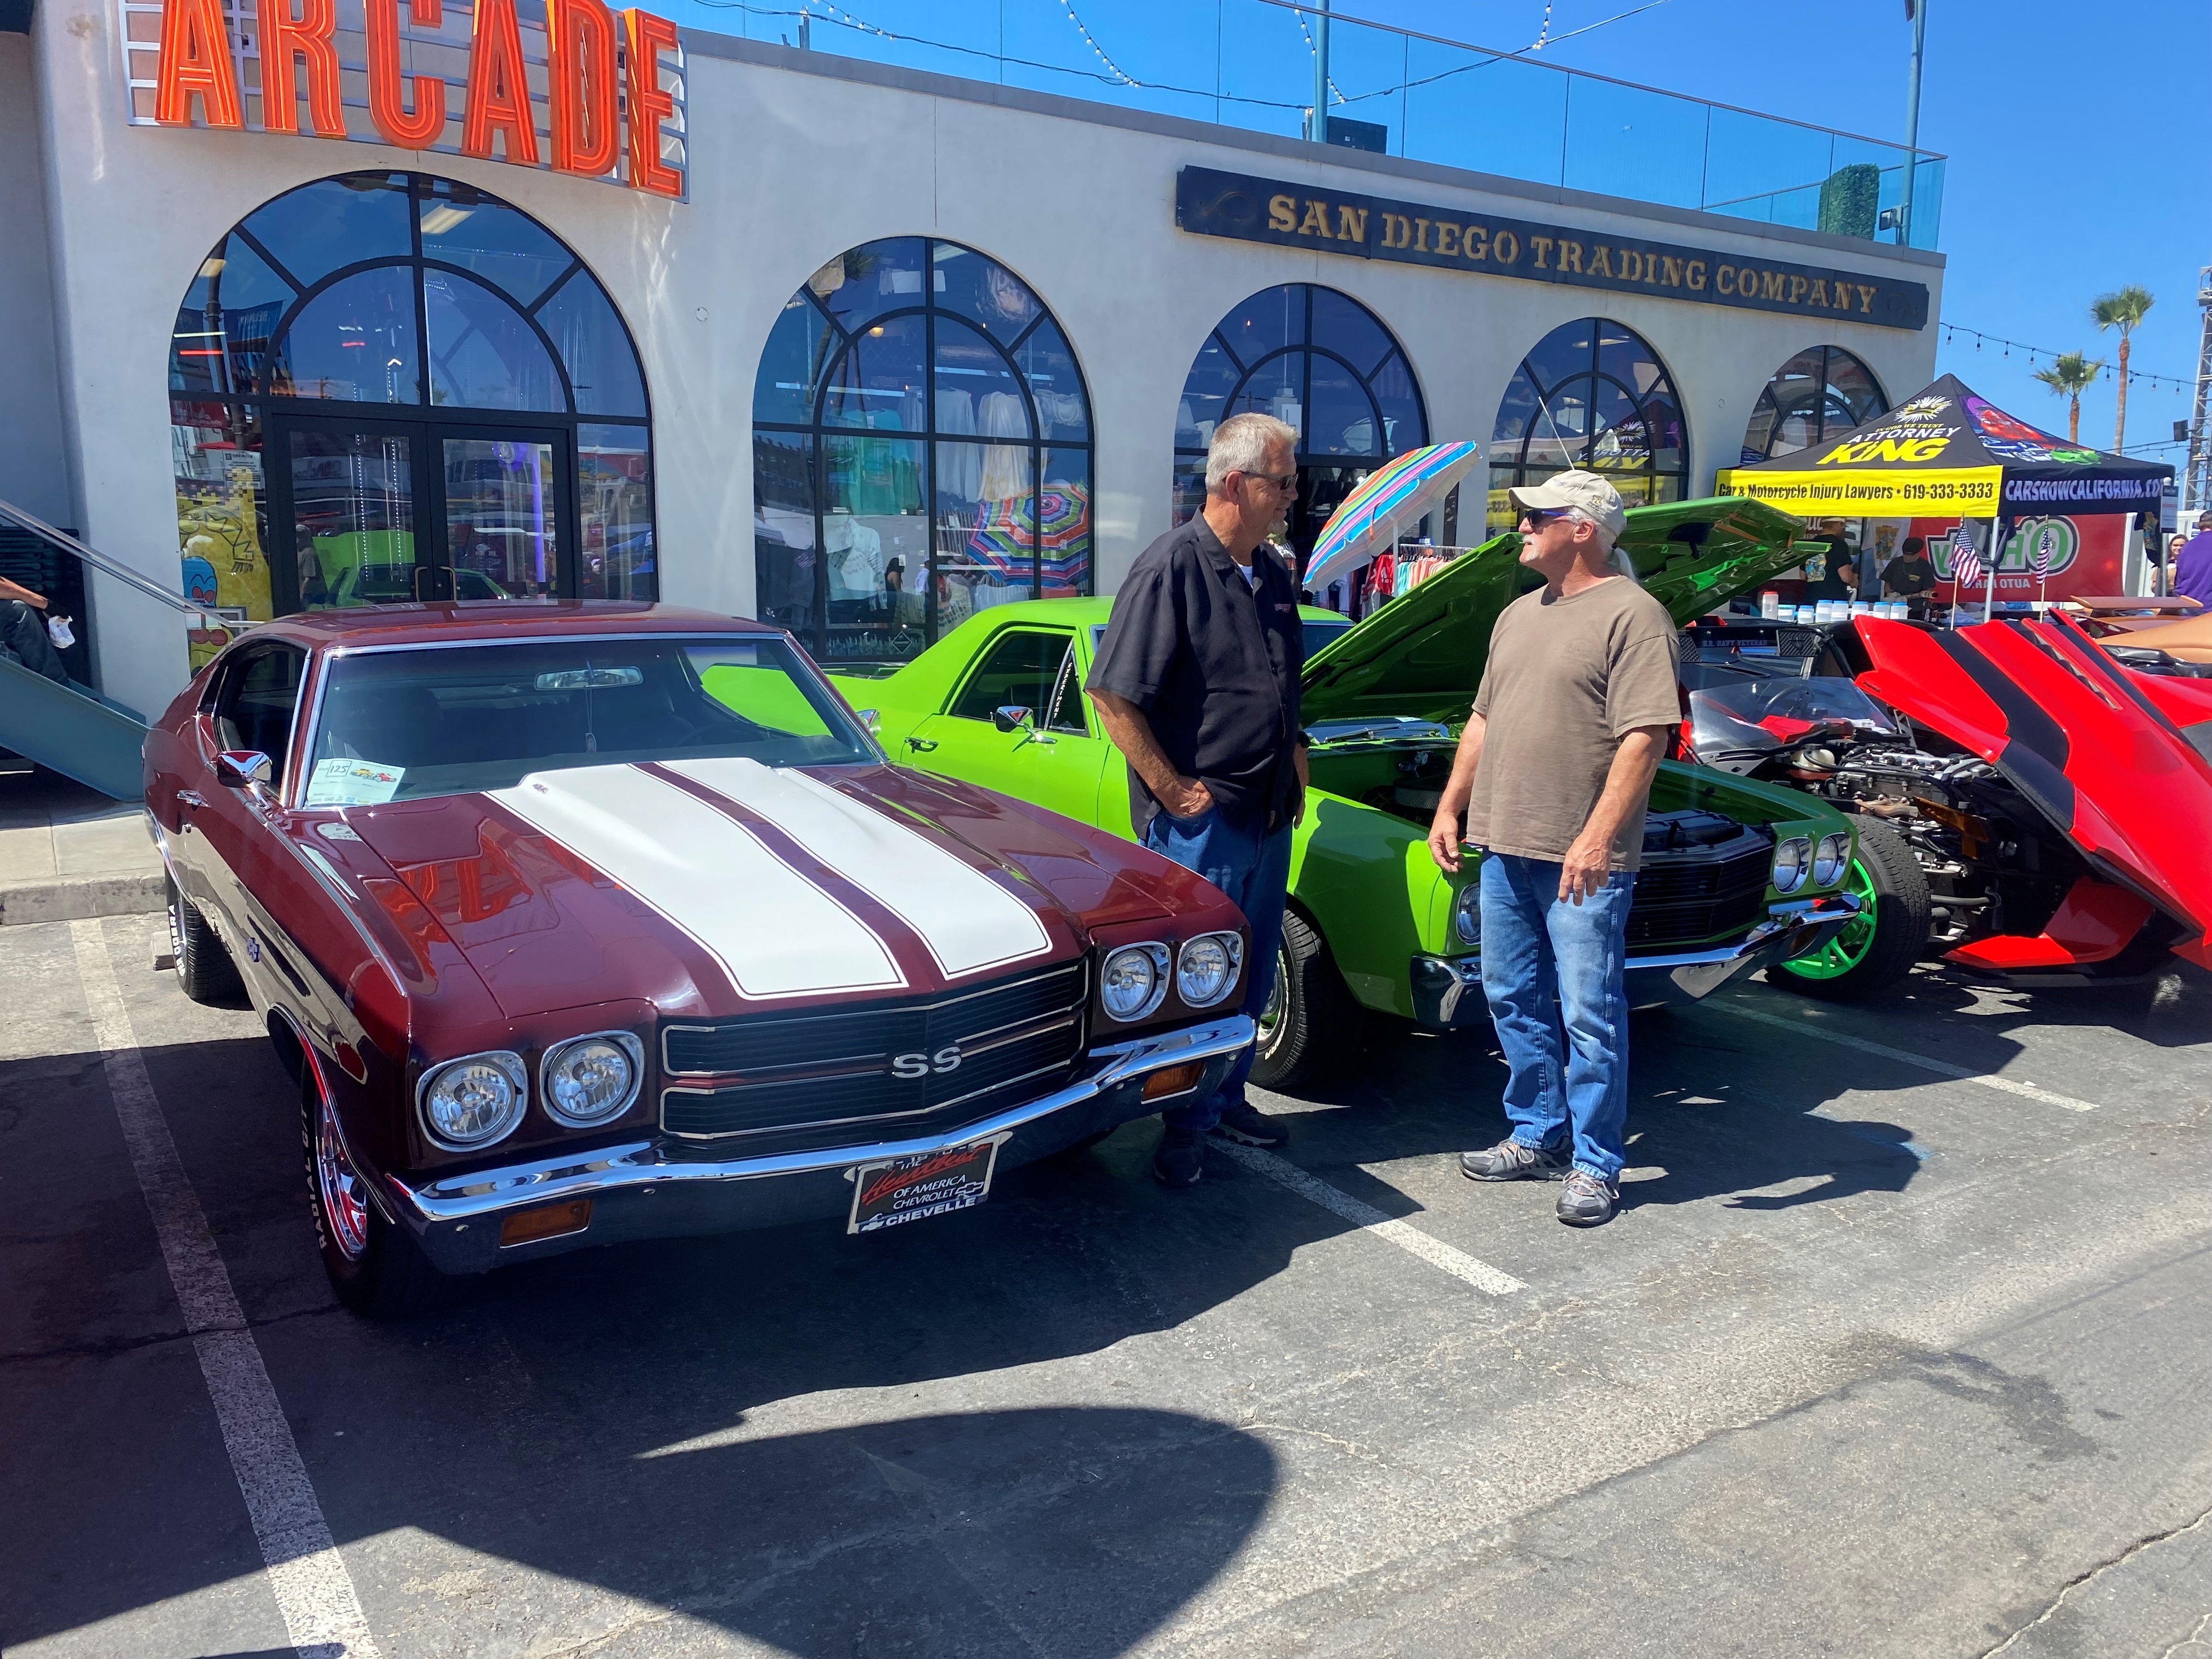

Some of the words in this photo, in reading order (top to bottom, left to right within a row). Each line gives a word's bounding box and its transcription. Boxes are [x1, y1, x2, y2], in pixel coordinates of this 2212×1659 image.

[154, 0, 682, 196] ARCADE
[1268, 194, 1370, 243] SAN
[1381, 212, 1522, 264] DIEGO
[1530, 236, 1709, 291] TRADING
[1716, 263, 1880, 314] COMPANY
[1847, 426, 1962, 443] ATTORNEY
[1719, 483, 1736, 496] Car
[1739, 486, 1746, 496] &
[1748, 483, 1807, 500] Motorcycle
[1810, 483, 1843, 500] Injury
[1845, 483, 1893, 500] Lawyers
[1904, 482, 1994, 500] 619-333-3333
[2006, 478, 2163, 501] CARSHOWCALIFORNIA.CO
[1053, 662, 1073, 719] EXPERIMENT
[330, 764, 349, 774] 125
[892, 1046, 961, 1079] SS
[893, 1187, 910, 1199] OF
[910, 1174, 966, 1195] AMERICA
[893, 1187, 957, 1210] CHEVROLET
[304, 1156, 328, 1250] RADIAL
[885, 1197, 976, 1226] CHEVELLE
